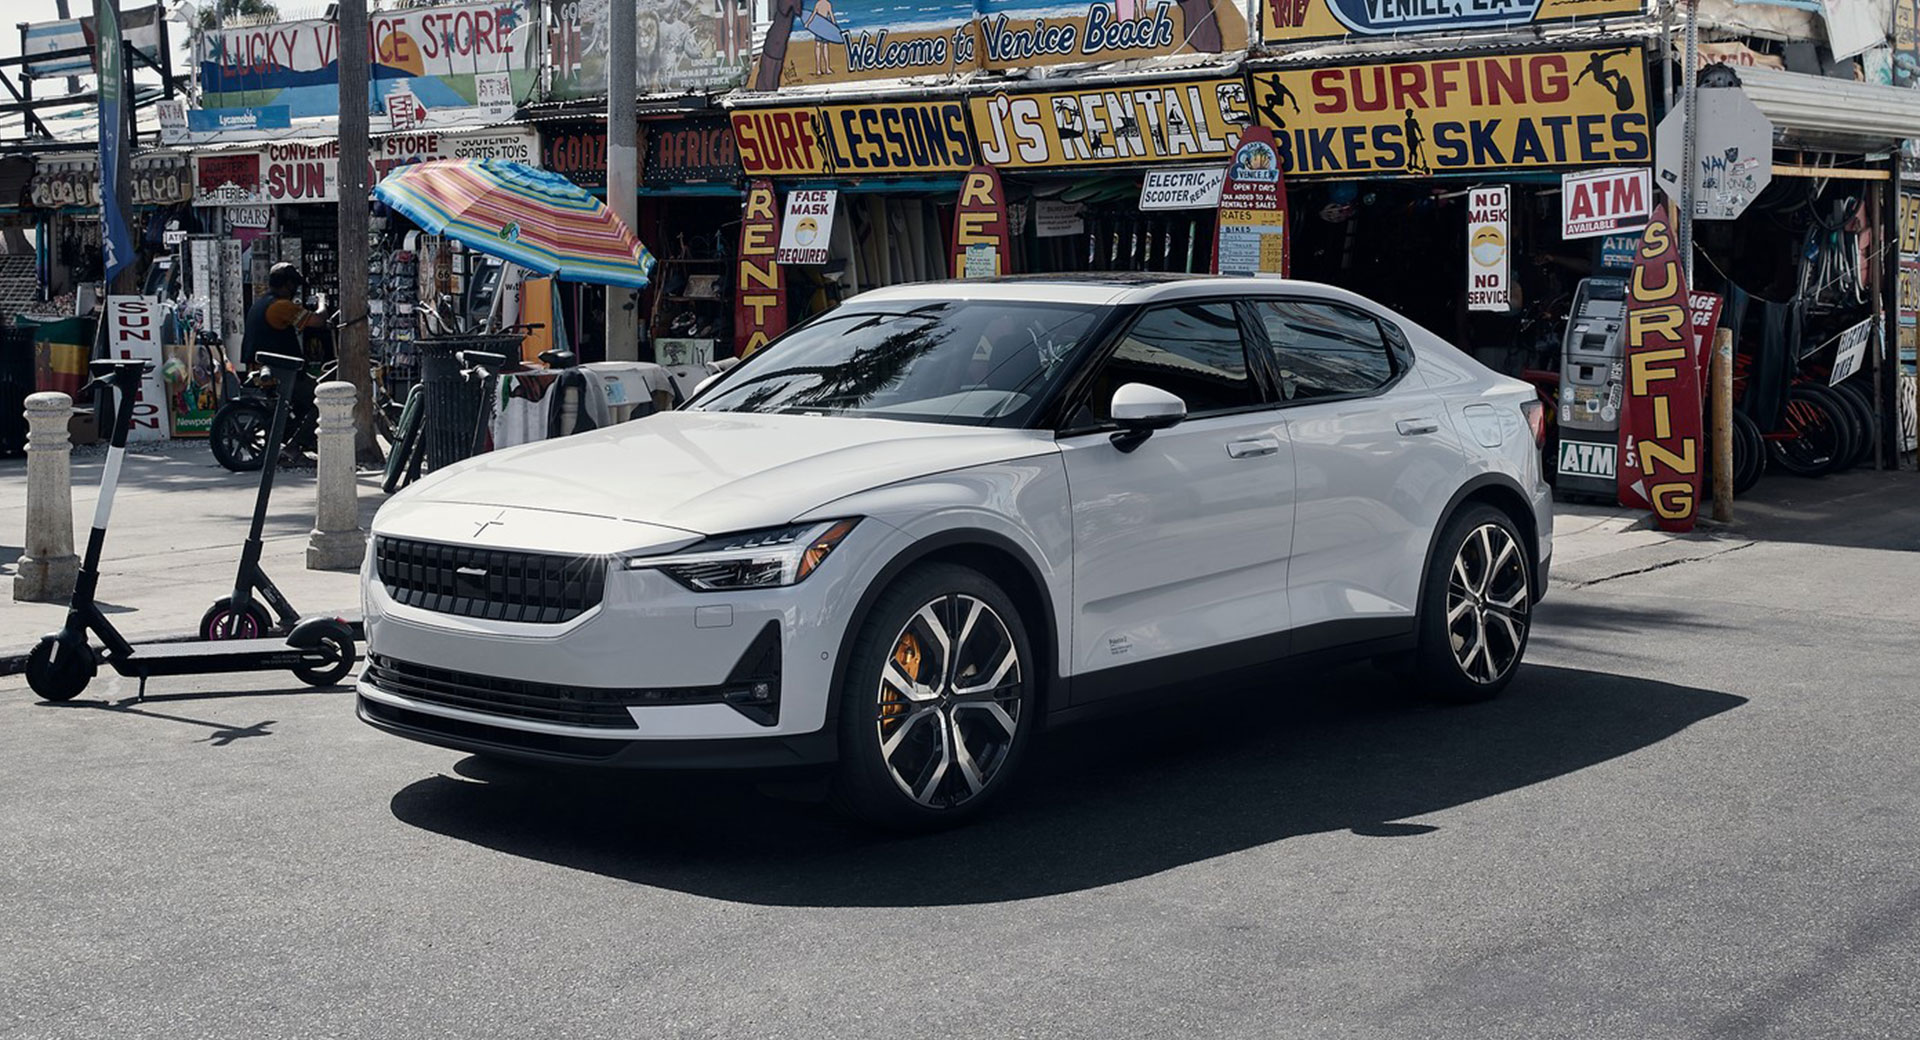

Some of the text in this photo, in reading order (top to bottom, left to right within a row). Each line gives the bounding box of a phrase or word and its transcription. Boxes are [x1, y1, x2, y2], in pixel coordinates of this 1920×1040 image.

[222, 8, 514, 78] LUCKY VICE STORE
[842, 29, 947, 72] Welcome
[952, 27, 974, 63] to
[980, 12, 1077, 61] Venice
[1082, 2, 1174, 54] Beach
[1311, 55, 1571, 114] SURFING
[981, 83, 1250, 164] J'S RENTALS
[732, 104, 973, 171] SURF LESSONS
[1271, 113, 1650, 173] BIKES SKATES
[270, 135, 438, 161] CONVENIE STORE
[501, 144, 528, 158] TOYS
[553, 129, 735, 172] GONZ AFRICA
[269, 163, 325, 199] SUN
[1148, 173, 1206, 187] ELECTRIC
[1233, 183, 1250, 191] OPEN
[207, 187, 249, 200] ATTERIES
[794, 191, 828, 202] FACE
[1144, 175, 1222, 204] SCOOTER RENTAL
[1255, 201, 1277, 209] SALES
[1475, 193, 1502, 207] NO
[1569, 176, 1644, 221] ATM
[228, 207, 269, 226] CIGARS
[790, 204, 829, 215] MASK
[1221, 211, 1252, 220] RATES
[1468, 208, 1508, 223] MASK
[1567, 219, 1615, 234] AVAILABLE
[1602, 237, 1639, 250] ATM
[777, 248, 829, 263] REQUIRED
[1474, 274, 1499, 288] NO
[1468, 290, 1508, 305] SERVICE
[118, 302, 151, 341] SUN
[1629, 221, 1697, 520] SURFING
[1562, 444, 1613, 475] ATM
